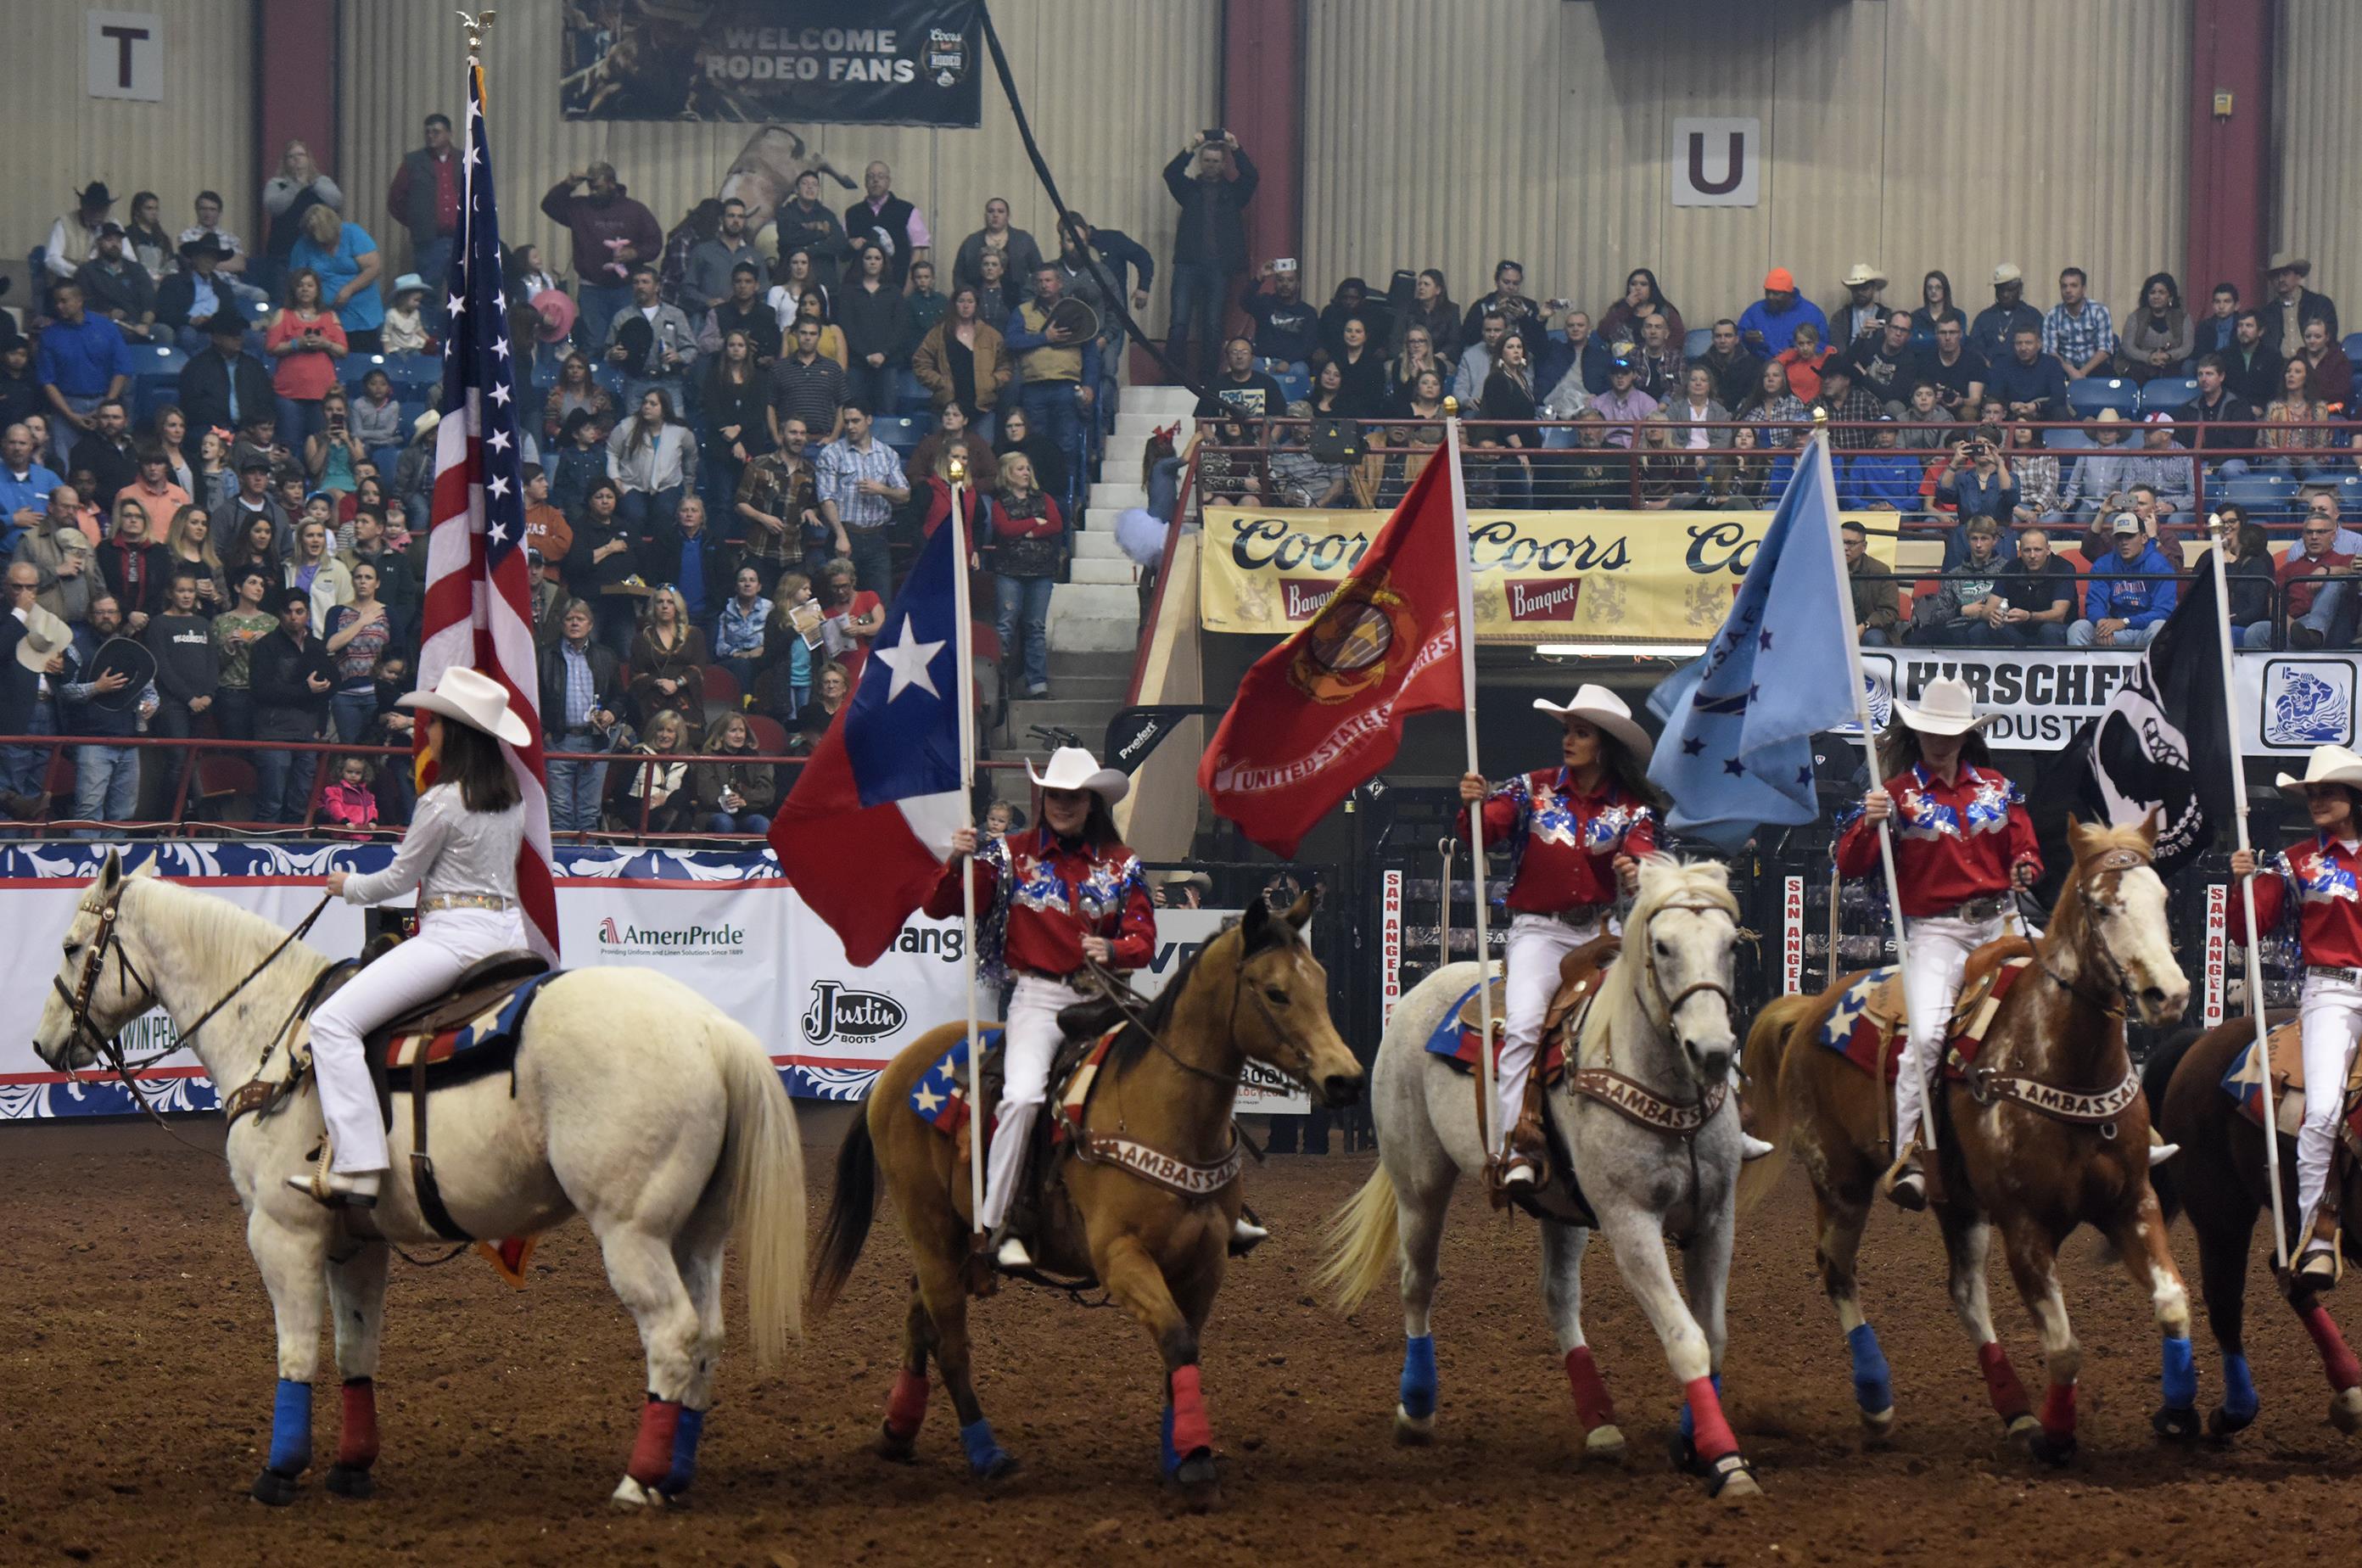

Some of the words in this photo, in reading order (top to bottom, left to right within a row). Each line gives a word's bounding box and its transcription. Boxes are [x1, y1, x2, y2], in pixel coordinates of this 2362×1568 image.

[725, 27, 897, 53] WELCOME
[930, 28, 961, 42] Coors
[102, 25, 148, 88] T
[705, 55, 819, 81] RODEO
[828, 58, 915, 82] FANS
[1688, 132, 1744, 195] U
[1232, 518, 1369, 571] Coor
[1468, 520, 1632, 573] Coors
[1514, 582, 1576, 618] Banquet
[1241, 757, 1318, 790] UNITED
[1385, 874, 1399, 911] SAN
[1787, 880, 1800, 919] SAN
[2210, 888, 2224, 928] SAN
[624, 924, 743, 945] AmeriPride
[1385, 919, 1398, 996] ANGELO
[1787, 927, 1799, 992] ANGEL
[2208, 936, 2223, 1018] ANGELO
[803, 983, 898, 1042] Justin
[841, 1035, 876, 1044] BOOTS
